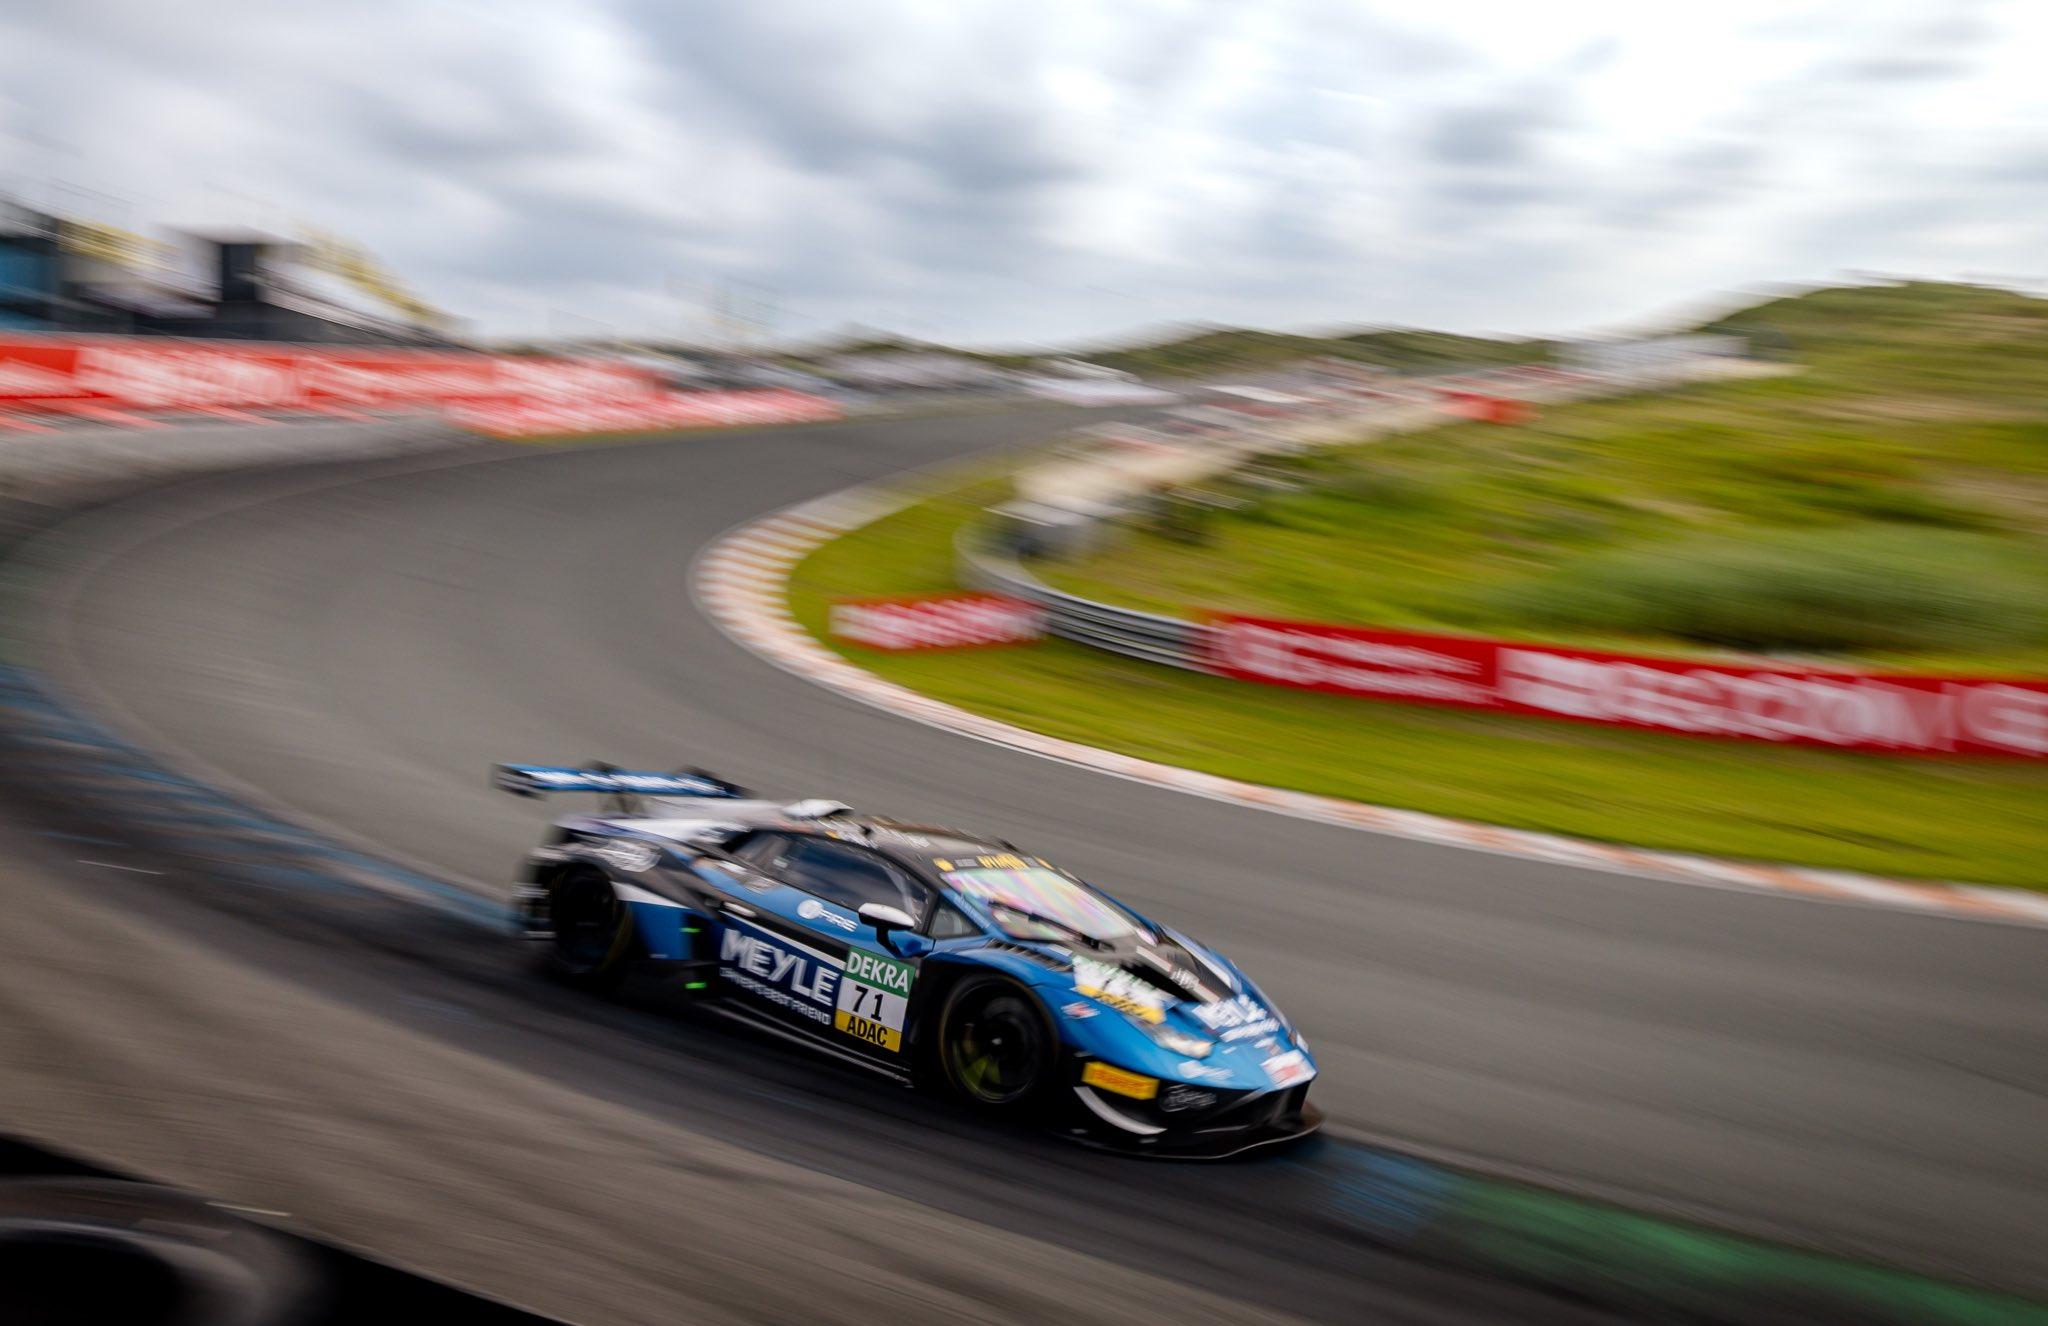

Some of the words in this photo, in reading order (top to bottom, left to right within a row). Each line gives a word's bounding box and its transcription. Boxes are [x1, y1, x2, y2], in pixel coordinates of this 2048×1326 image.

[720, 928, 839, 1007] MEYLE
[846, 951, 908, 992] DEKRA
[852, 984, 884, 1022] 71
[846, 1015, 889, 1046] ADAC
